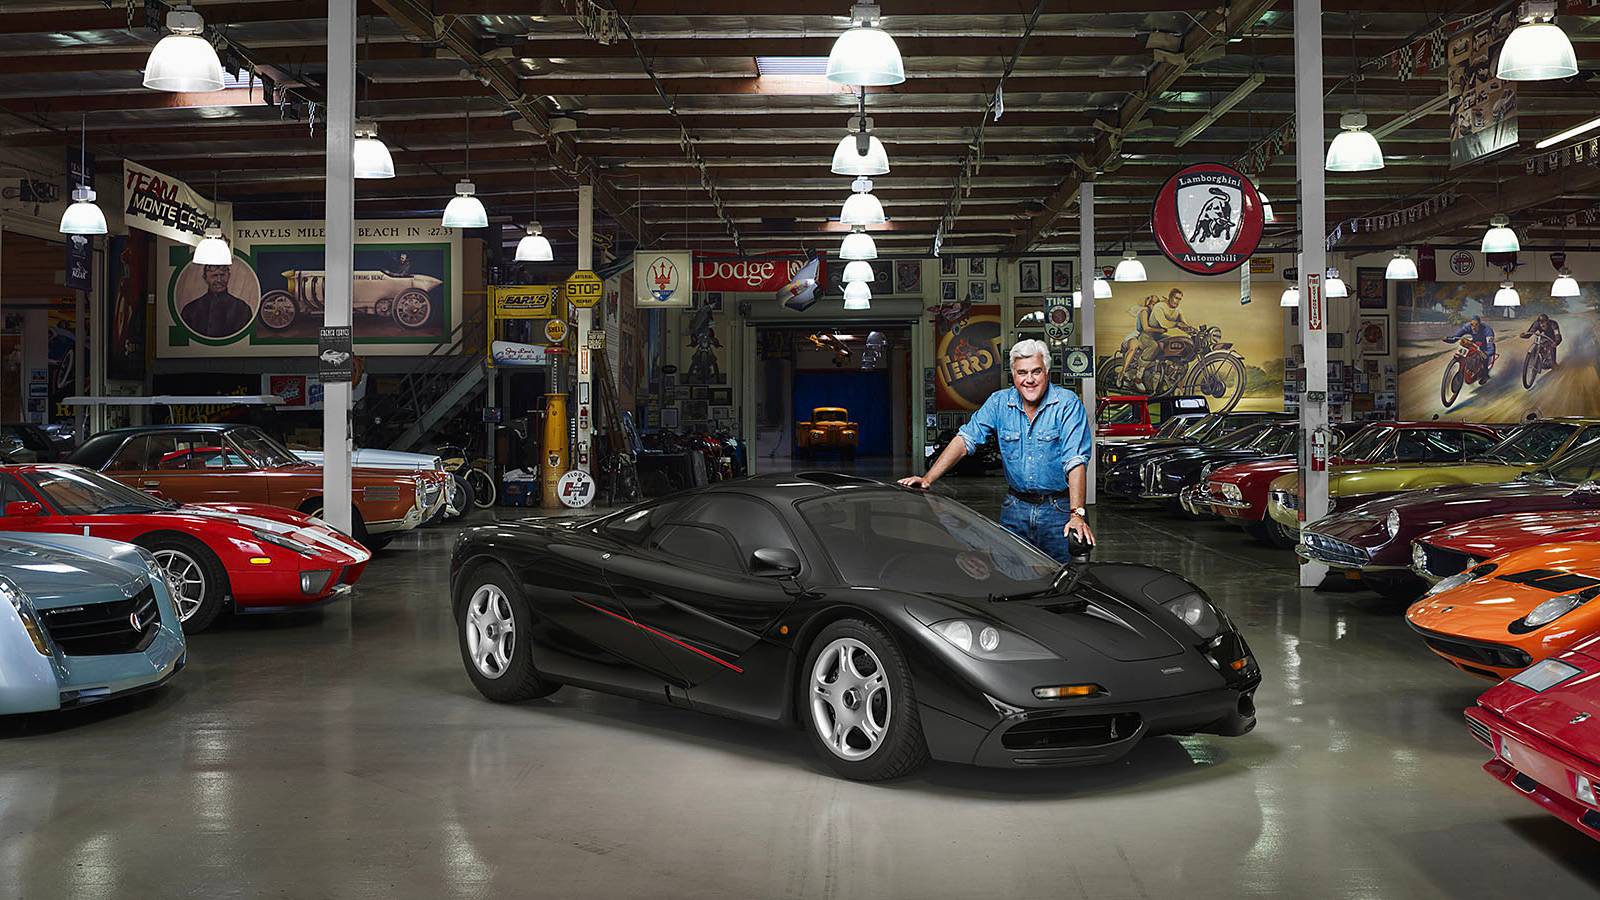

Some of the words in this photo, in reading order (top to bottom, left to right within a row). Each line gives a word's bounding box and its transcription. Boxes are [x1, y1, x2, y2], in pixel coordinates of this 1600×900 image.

[1178, 174, 1242, 187] Lamborghini
[126, 169, 179, 204] TEAM
[132, 193, 177, 221] MONTE
[178, 208, 209, 232] CARL
[237, 230, 291, 239] TRAVELS
[358, 228, 399, 237] BEACH
[407, 228, 420, 237] IN
[1183, 254, 1238, 263] Automobili
[697, 257, 775, 286] Dodge
[568, 284, 600, 295] STOP
[505, 295, 547, 304] EARL'S
[1045, 297, 1072, 307] TIME
[547, 326, 565, 334] SHELL
[1048, 327, 1071, 337] GAS
[938, 336, 1003, 383] TERROT
